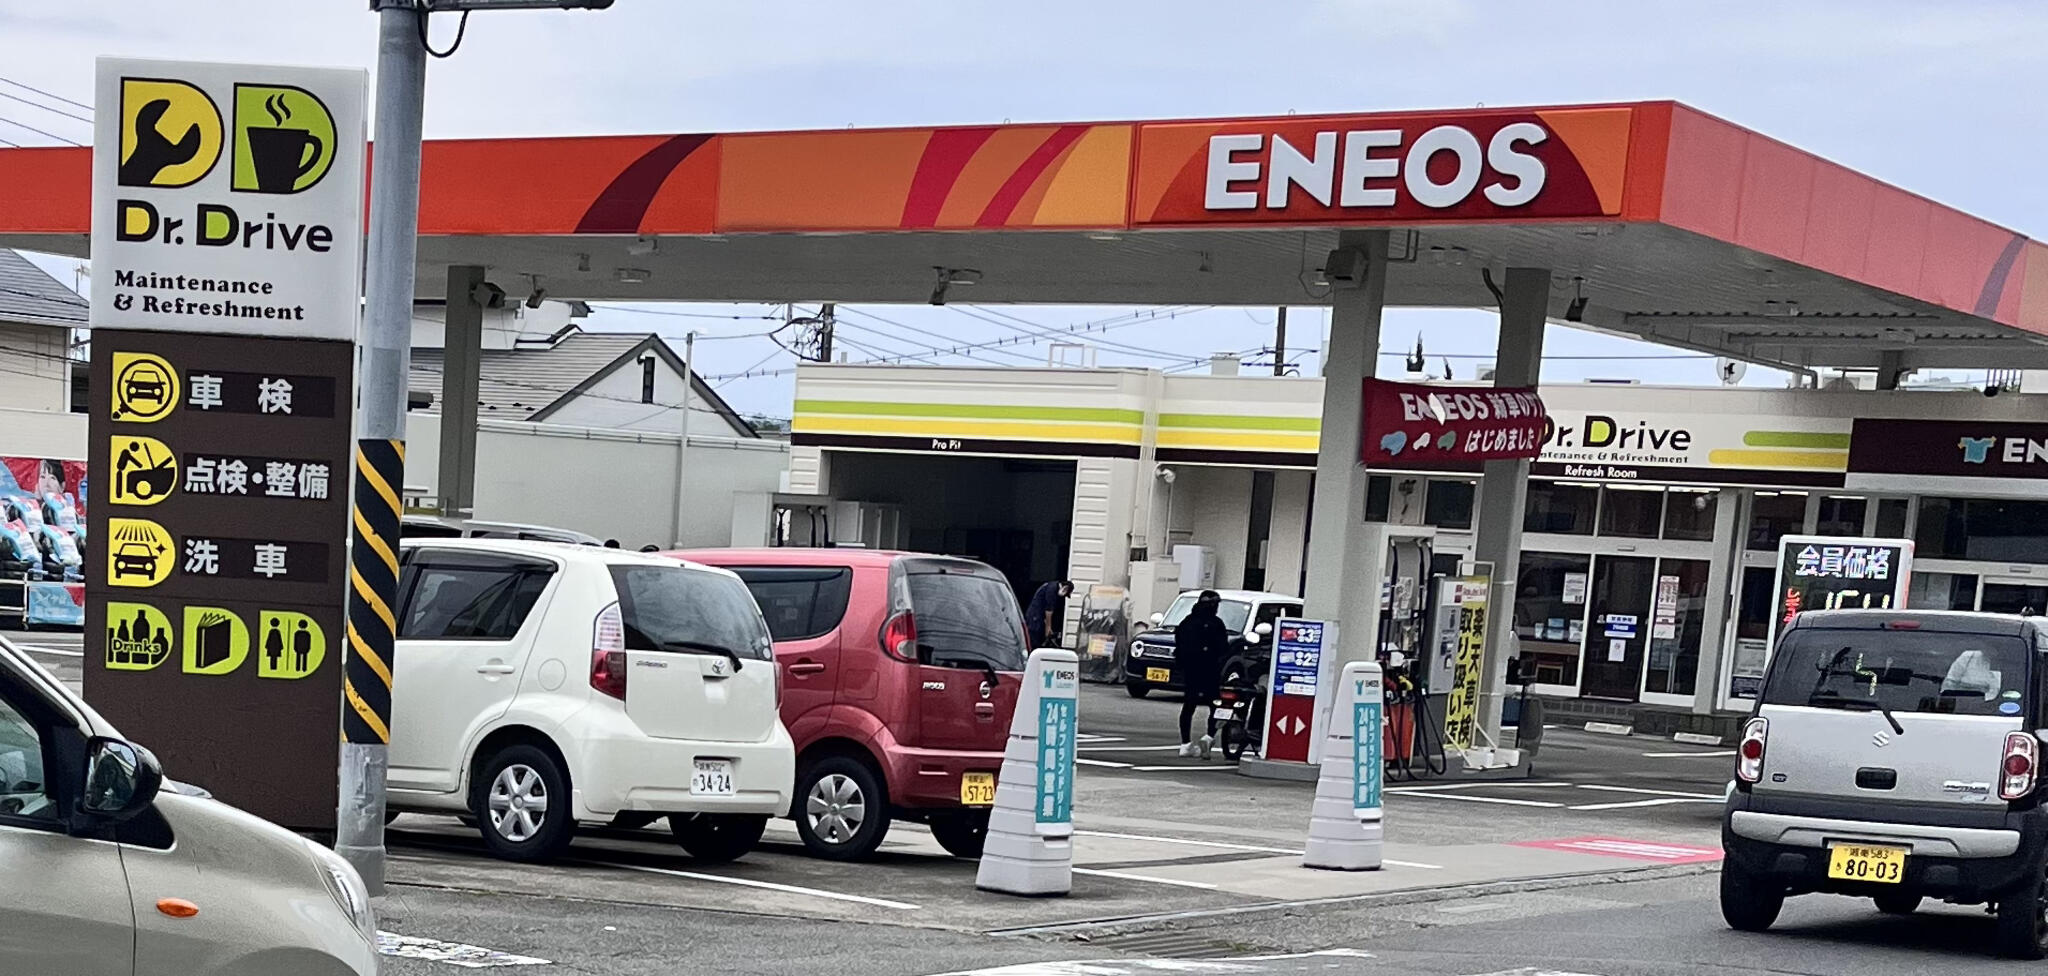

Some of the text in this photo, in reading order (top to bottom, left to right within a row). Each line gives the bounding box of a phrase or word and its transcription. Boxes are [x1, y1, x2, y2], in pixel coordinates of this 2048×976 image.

[1204, 122, 1548, 210] ENEOS
[116, 199, 333, 252] Dr. Drive
[114, 269, 273, 295] Maintenance
[113, 293, 304, 320] & Refreshment
[932, 438, 947, 450] Pro
[1583, 415, 1691, 451] Drive
[184, 457, 329, 499] 点検・整備
[1565, 465, 1638, 479] Refresh Room
[1795, 545, 1891, 579] 会員価格
[112, 638, 161, 654] Drinks
[1845, 859, 1899, 880] 80-03
